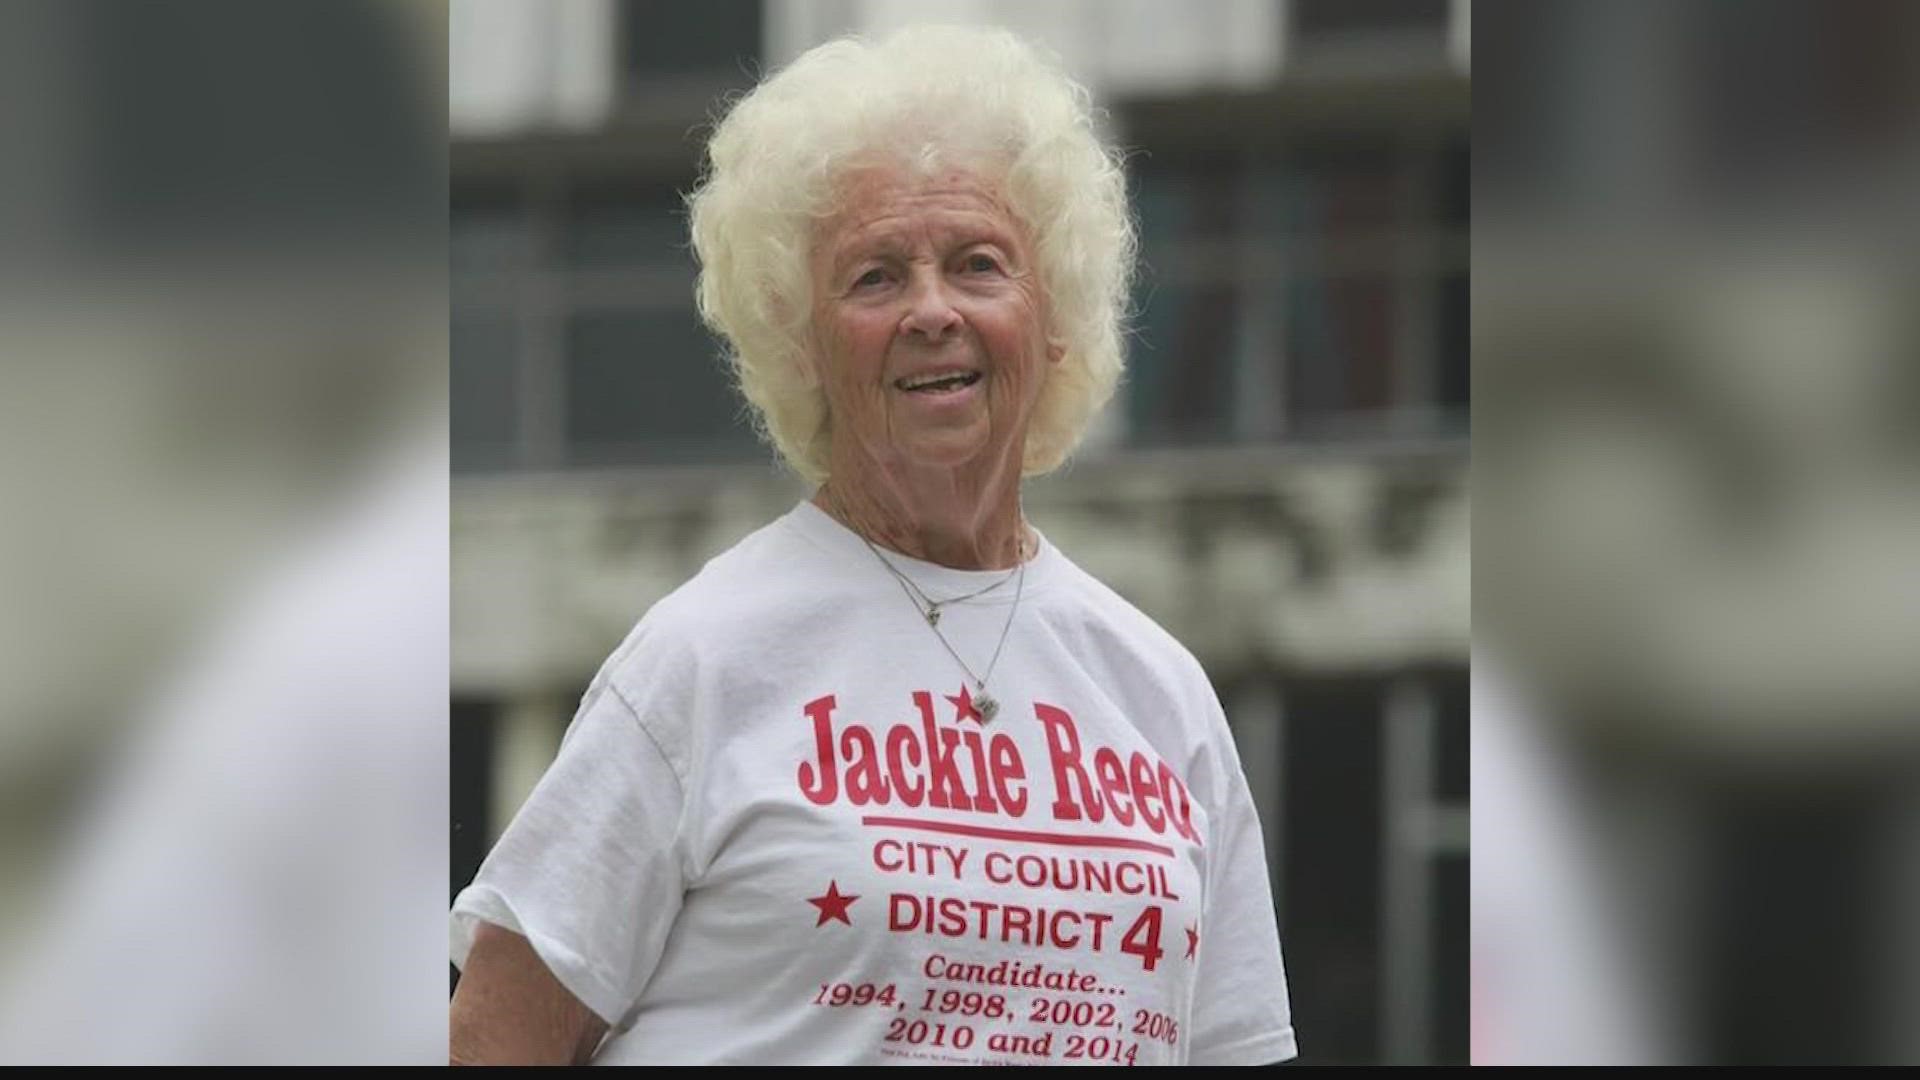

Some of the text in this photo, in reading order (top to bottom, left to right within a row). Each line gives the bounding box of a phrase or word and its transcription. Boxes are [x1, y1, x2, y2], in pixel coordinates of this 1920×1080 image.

[798, 691, 1027, 818] Jackie
[874, 839, 1179, 900] CITY COUNCIL
[888, 893, 1164, 972] DISTRICT 4
[924, 954, 1126, 996] Candidate...
[812, 984, 905, 1012] 1994,
[919, 989, 1015, 1023] 1998,
[1029, 999, 1122, 1032] 2002,
[884, 1018, 975, 1050] 2010
[987, 1032, 1053, 1058] and
[1064, 1036, 1138, 1066] 2014
